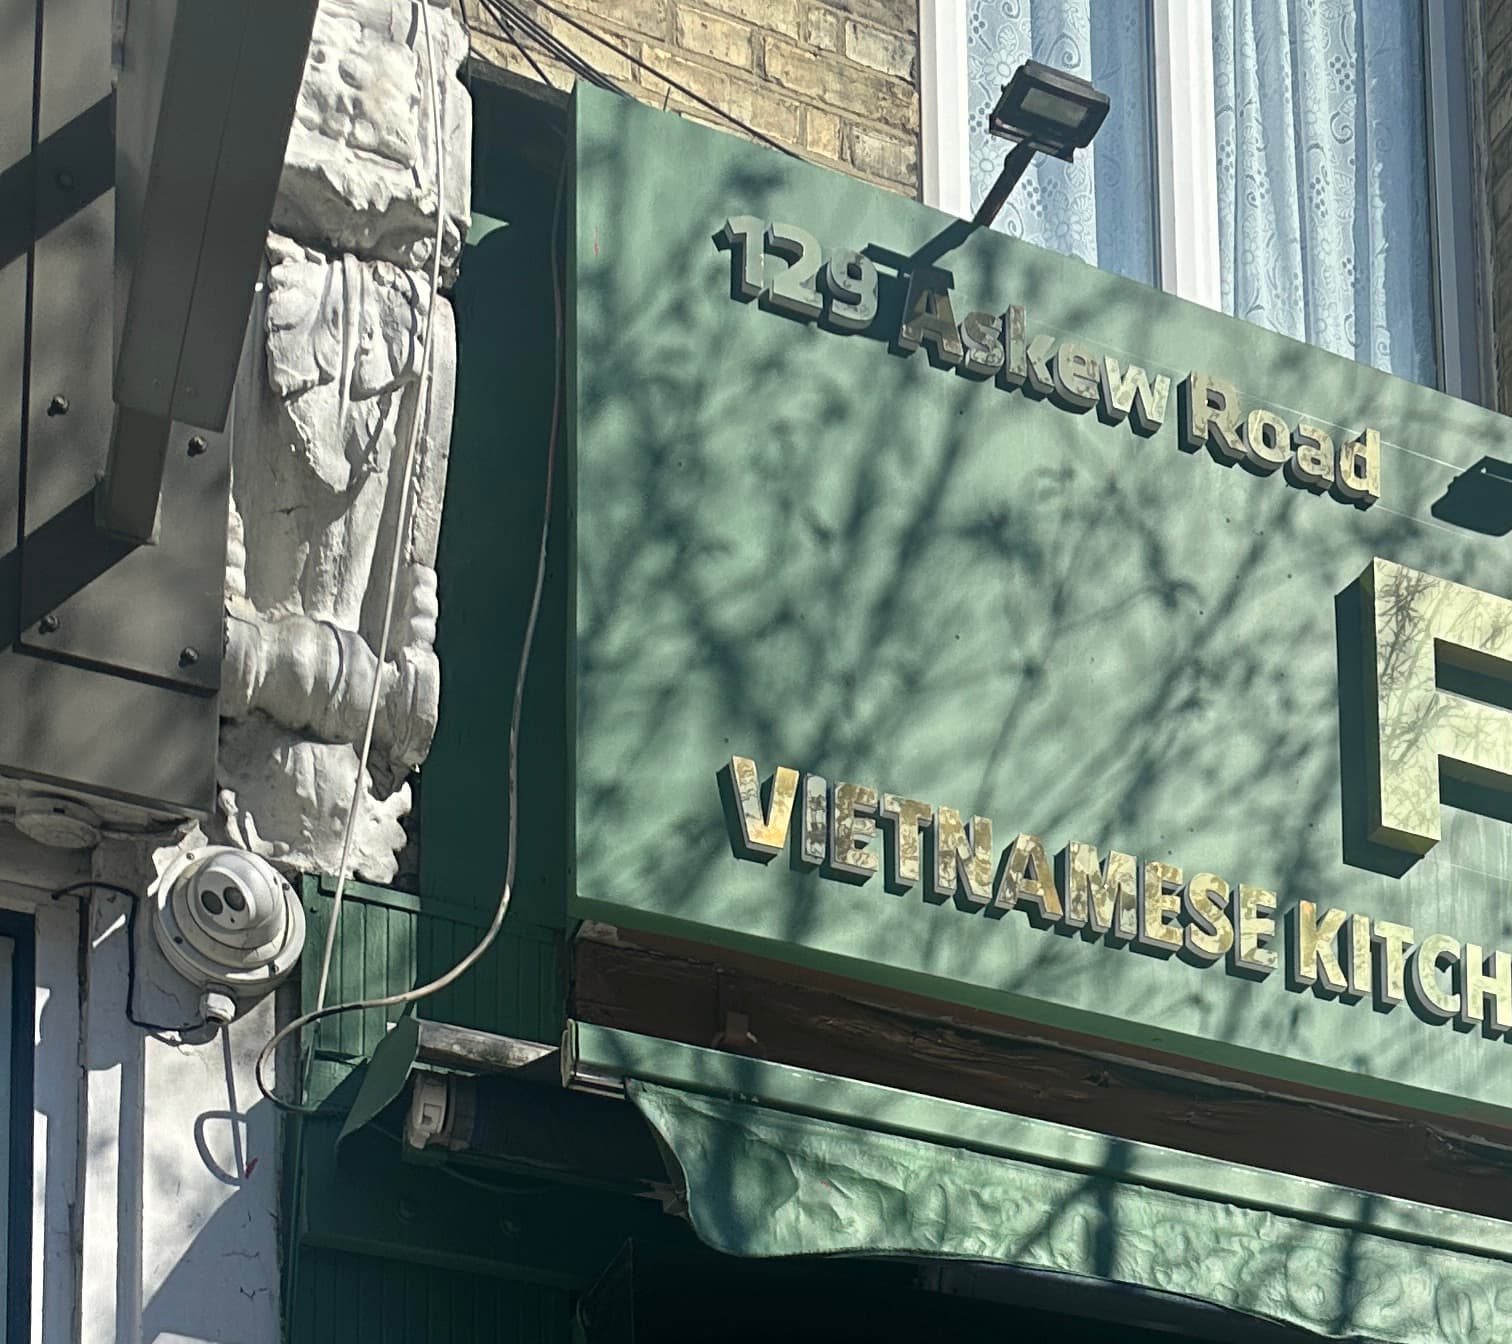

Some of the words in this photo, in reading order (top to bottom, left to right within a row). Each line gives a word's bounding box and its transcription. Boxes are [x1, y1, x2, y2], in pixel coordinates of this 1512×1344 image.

[722, 215, 878, 330] 129
[897, 264, 1172, 434] Askew
[1184, 369, 1381, 506] Road
[728, 754, 1280, 972] VIETNAMESE
